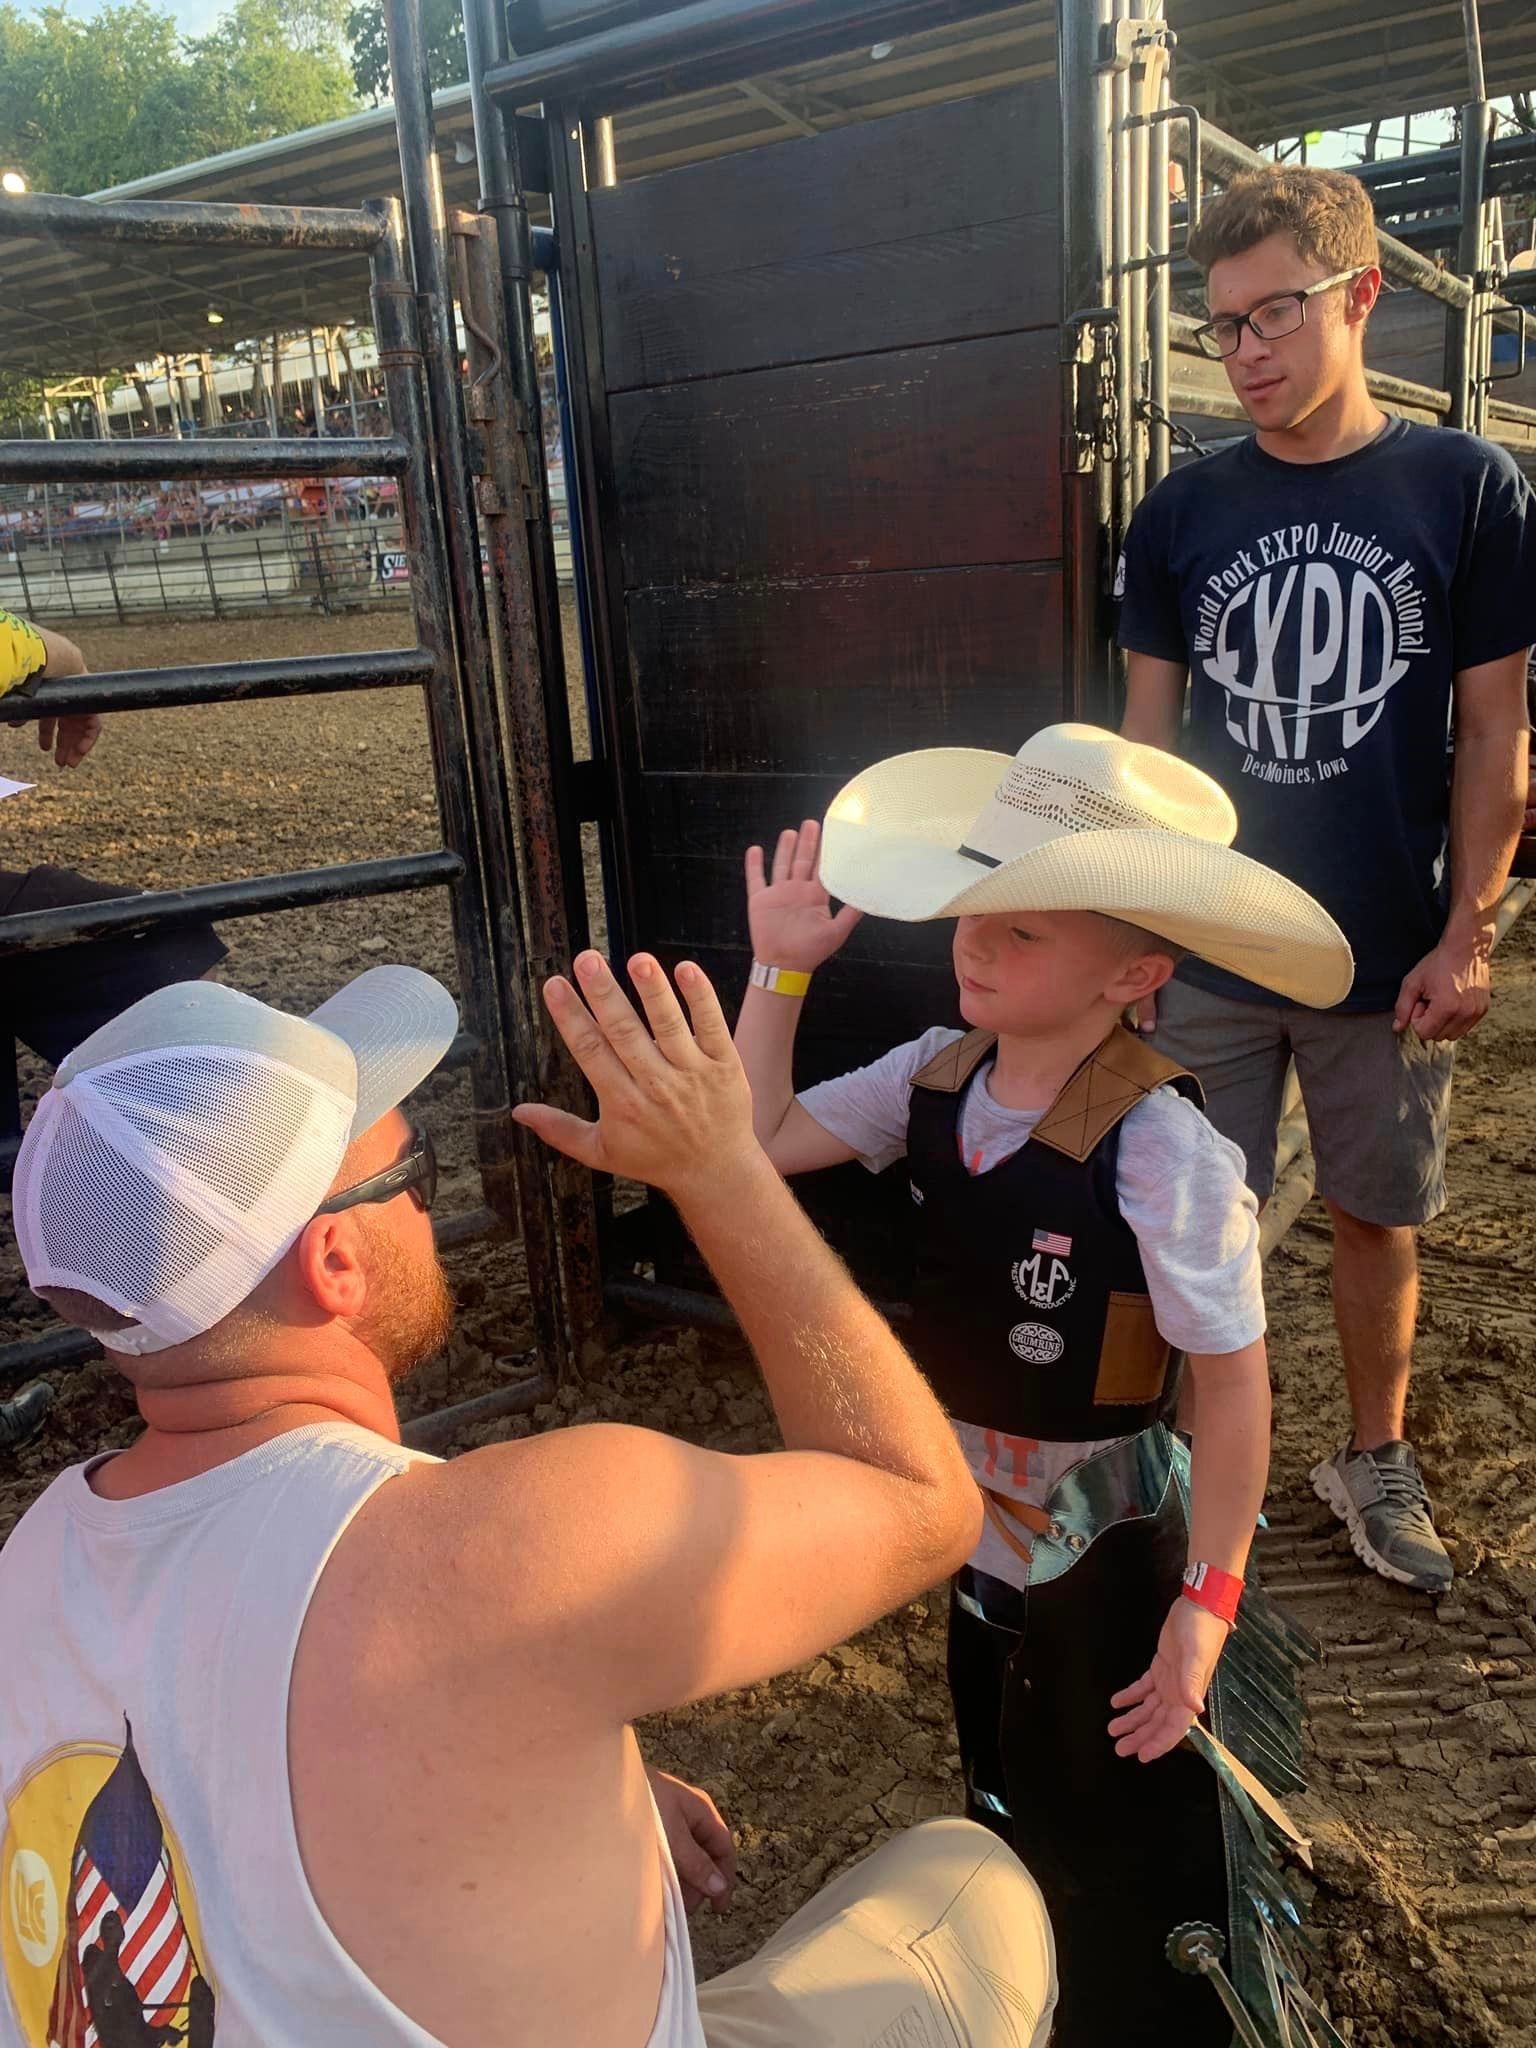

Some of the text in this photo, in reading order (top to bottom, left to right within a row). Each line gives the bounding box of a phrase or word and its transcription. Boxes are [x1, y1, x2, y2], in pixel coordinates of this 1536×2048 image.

[1194, 522, 1431, 654] World Pork EXPO Junior National
[1203, 562, 1410, 760] EXPO
[1316, 757, 1349, 781] Iowa
[1012, 1332, 1061, 1352] CRUMRINE
